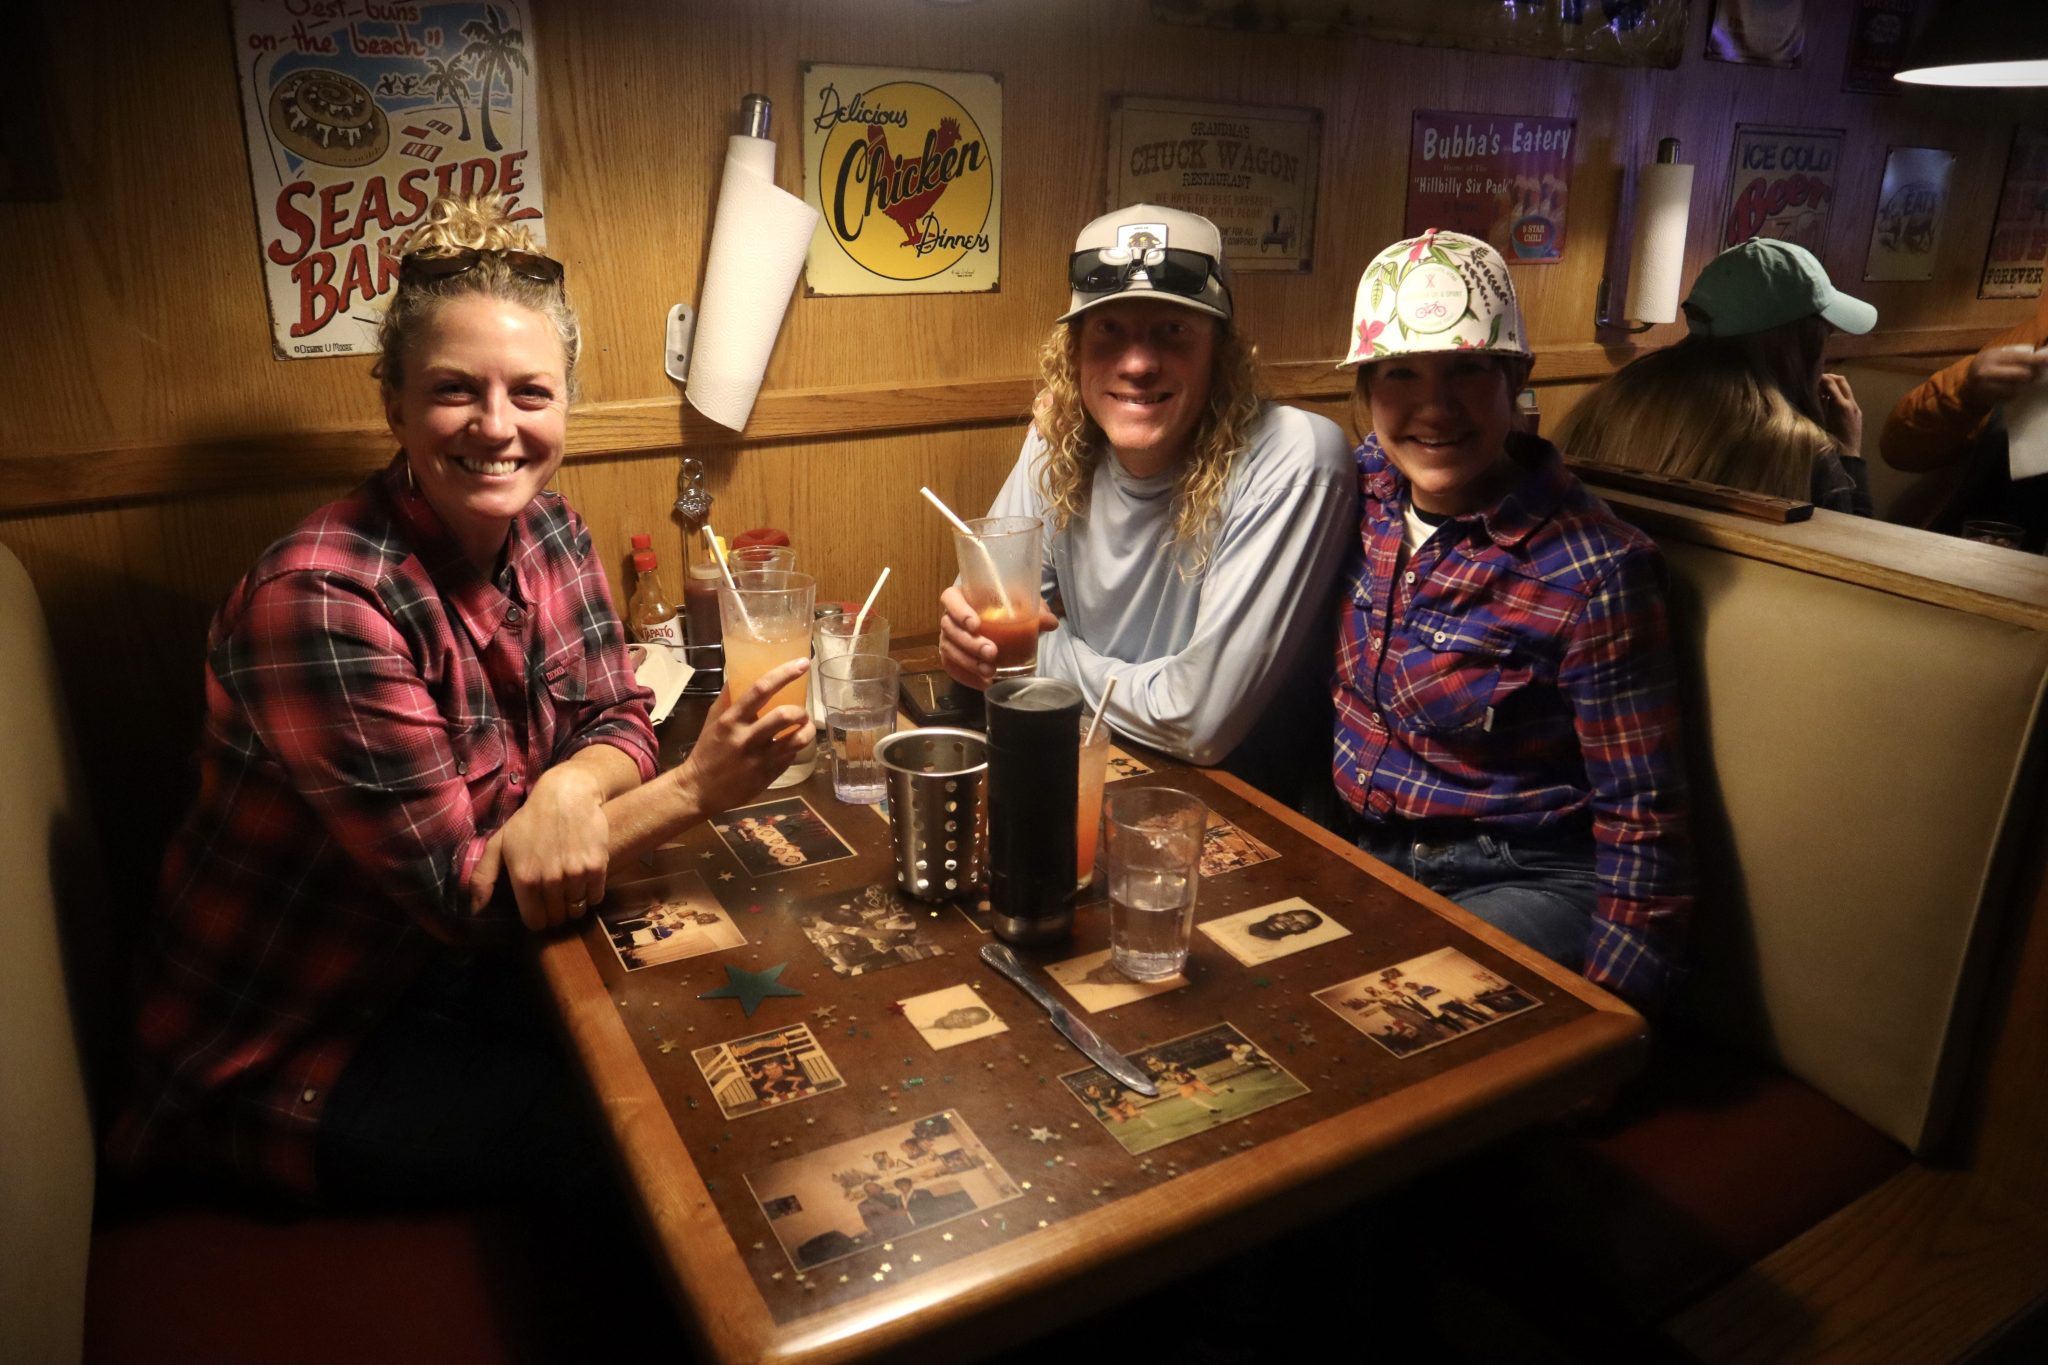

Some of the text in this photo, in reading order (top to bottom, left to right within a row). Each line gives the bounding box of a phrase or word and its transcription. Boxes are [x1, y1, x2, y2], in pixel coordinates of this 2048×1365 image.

[291, 19, 336, 52] the
[814, 82, 908, 134] Delicious
[1129, 138, 1300, 184] CHUCK WAGON
[1423, 121, 1572, 161] Bubba's Eatery
[1743, 143, 1832, 172] ICE COLD
[834, 128, 987, 242] Chicken
[1182, 172, 1252, 190] RESTAURANT
[1465, 177, 1481, 195] Six
[267, 150, 528, 266] SEASIDE
[1726, 173, 1833, 247] Beer
[916, 211, 989, 258] Dinners
[1985, 266, 2045, 285] FOREVER
